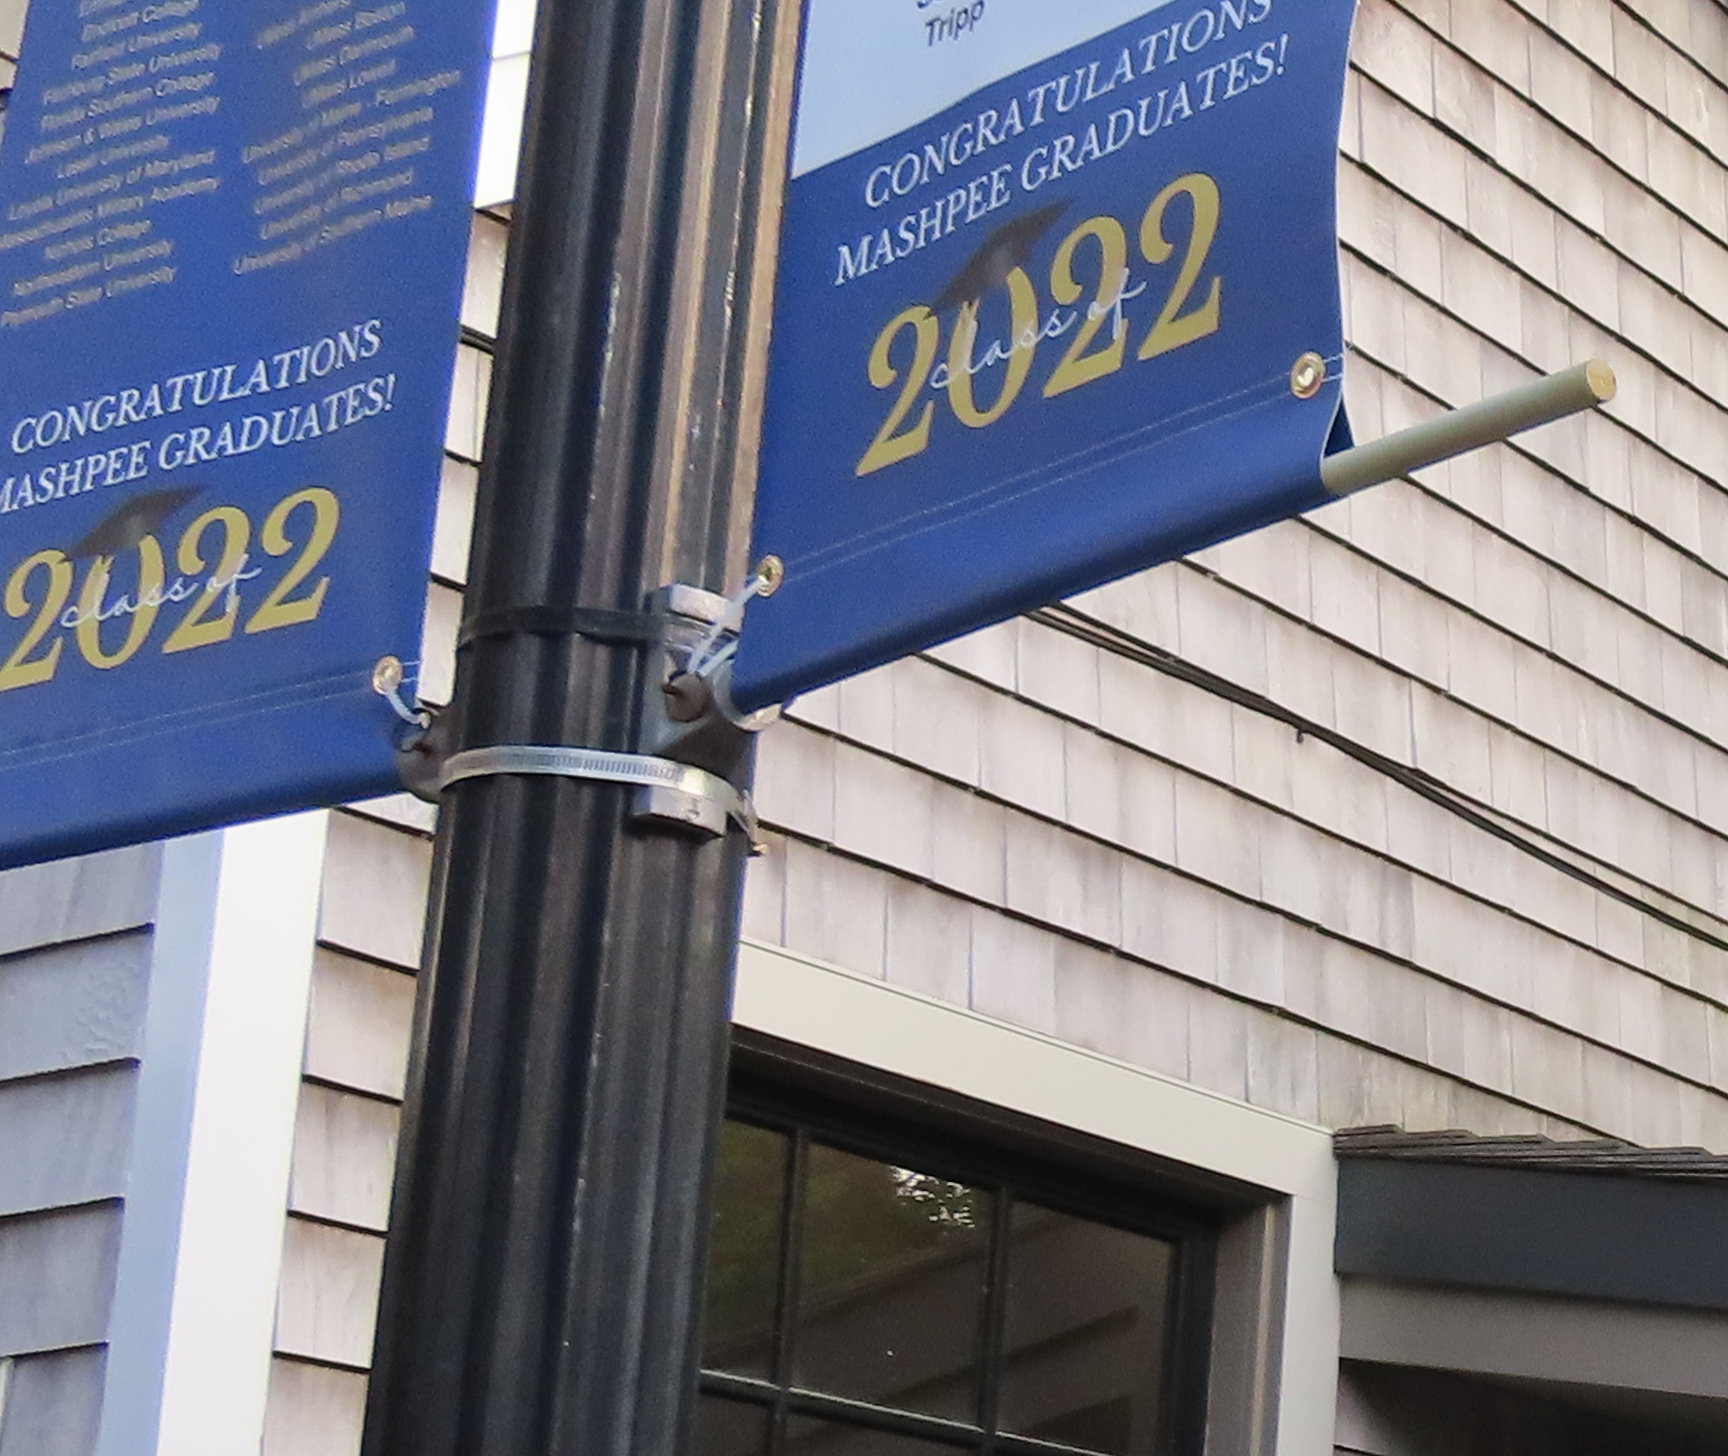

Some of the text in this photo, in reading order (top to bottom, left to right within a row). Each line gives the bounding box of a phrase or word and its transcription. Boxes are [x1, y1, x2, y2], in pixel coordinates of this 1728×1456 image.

[925, 0, 985, 46] Tripp
[834, 34, 1289, 286] MASHPEE GRADUATES!
[865, 0, 1272, 207] CONGRATULATIONS
[11, 319, 382, 454] CONGRATULATIONS
[856, 172, 1221, 477] 2022
[931, 300, 1077, 389] class
[158, 374, 397, 471] GRADUATES!
[0, 487, 340, 691] 2022
[60, 553, 201, 628] class
